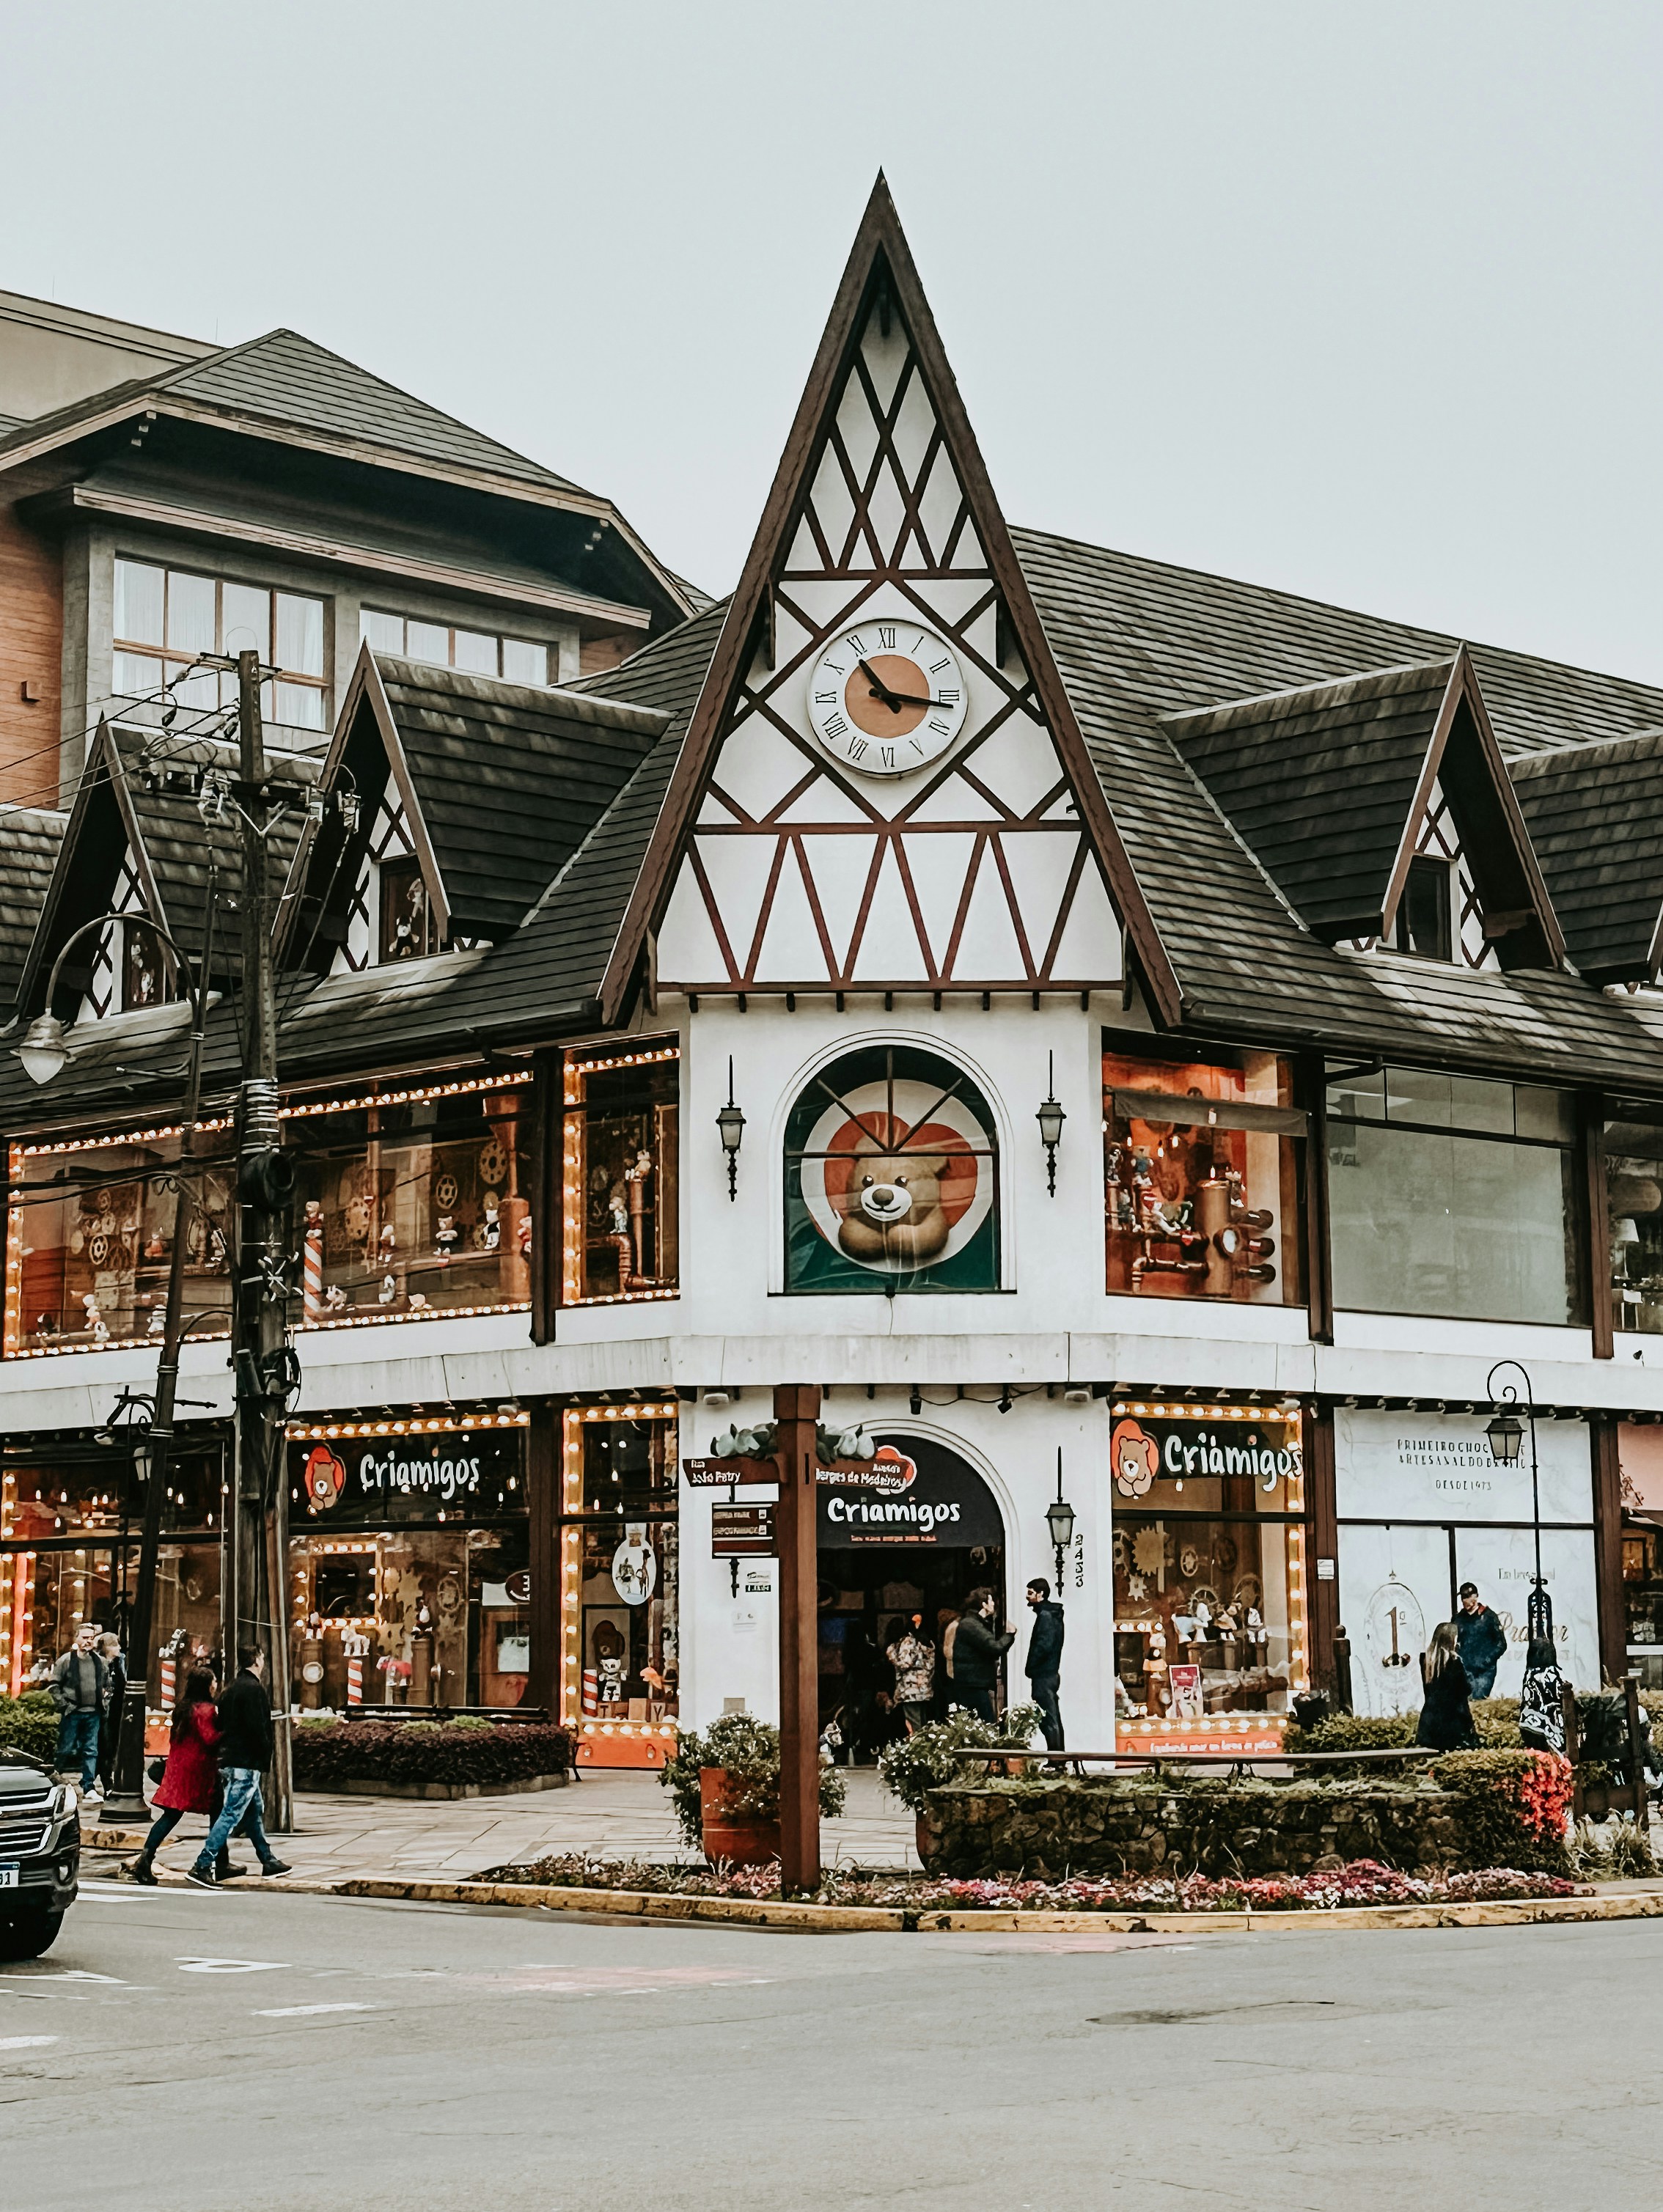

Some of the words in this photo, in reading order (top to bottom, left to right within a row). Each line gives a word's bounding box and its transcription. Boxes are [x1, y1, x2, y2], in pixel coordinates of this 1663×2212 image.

[846, 634, 867, 657] XI
[878, 628, 896, 648] XII
[911, 636, 924, 654] I
[823, 658, 845, 675] X
[929, 658, 951, 674] II
[815, 691, 837, 704] IX
[822, 712, 848, 740] VIII
[928, 716, 950, 736] IV
[847, 735, 869, 761] VII
[881, 746, 895, 768] VI
[909, 738, 924, 756] V
[1398, 1438, 1455, 1452] PRIMEIRO
[1164, 1433, 1302, 1492] Criamigos
[1469, 1456, 1483, 1467] DO
[360, 1450, 480, 1499] Criamigos
[828, 1496, 961, 1532] Criamigos
